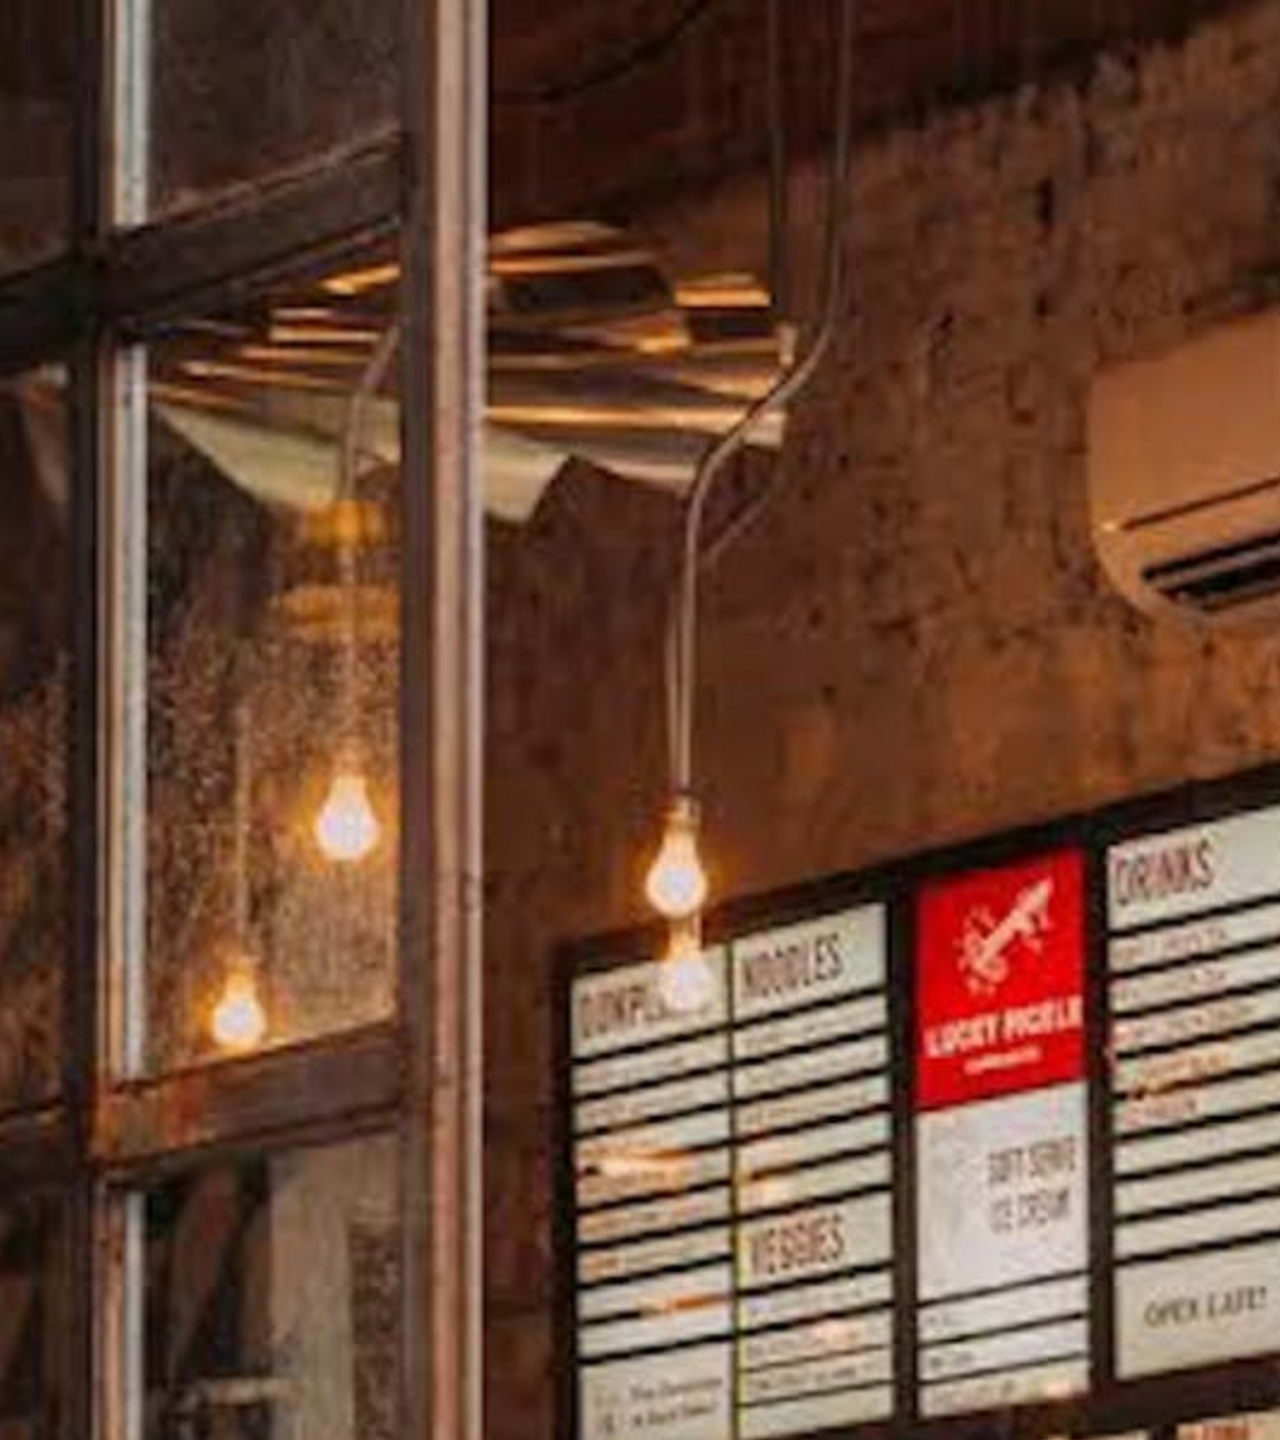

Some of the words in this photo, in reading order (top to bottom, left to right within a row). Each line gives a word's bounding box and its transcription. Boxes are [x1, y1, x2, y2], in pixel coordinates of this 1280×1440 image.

[1114, 838, 1215, 905] DRINKS
[740, 932, 844, 1000] NOODLES
[923, 1011, 998, 1060] LUCKY
[748, 1212, 846, 1277] VEGGIES
[1142, 1298, 1198, 1329] OPEN
